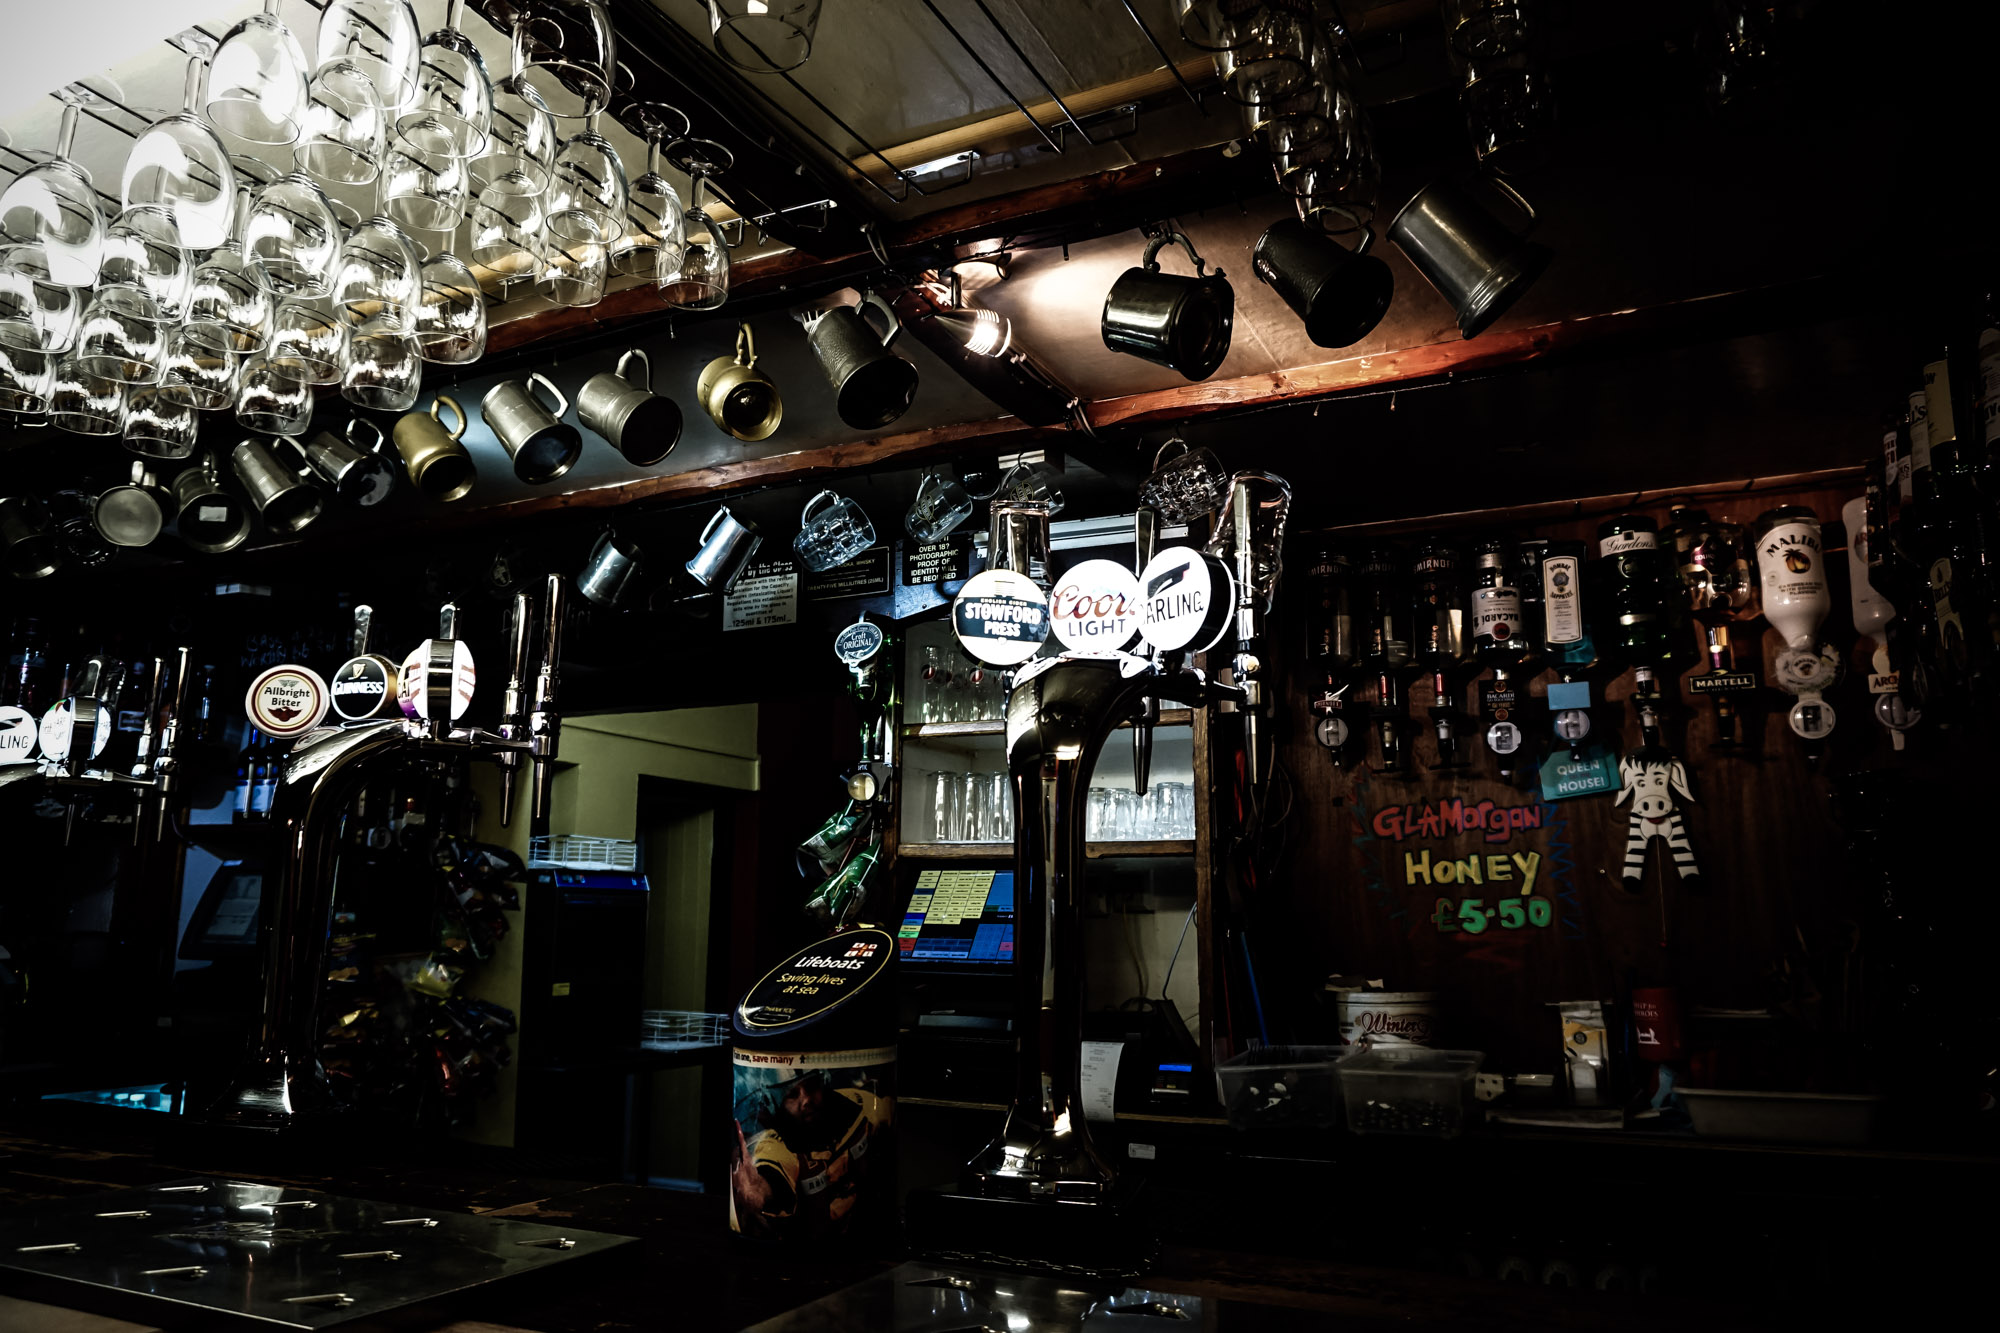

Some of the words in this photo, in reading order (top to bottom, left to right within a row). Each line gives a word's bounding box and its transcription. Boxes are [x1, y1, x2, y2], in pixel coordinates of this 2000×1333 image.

[919, 545, 936, 553] OVER
[1766, 534, 1820, 558] MALIBU
[909, 548, 959, 562] PHOTOGRAPHIC
[917, 560, 939, 568] PROOF
[911, 567, 939, 576] IDENTITY
[965, 603, 1041, 624] STOWFORD
[1140, 591, 1204, 625] ARLING
[732, 619, 755, 627] 125ml
[764, 615, 787, 623] 175ml
[984, 621, 1020, 637] PRESS
[1069, 619, 1125, 637] LIGHT
[843, 638, 873, 649] ORIGINAL
[333, 681, 384, 695] GUINNESS
[1696, 677, 1750, 687] MARTELL
[264, 687, 310, 698] Allbright
[272, 698, 301, 706] Bitter
[1557, 760, 1600, 776] QUEEN
[1558, 777, 1604, 792] HOUSE!
[794, 956, 865, 970] Lifeboats
[776, 973, 817, 986] Saving
[817, 974, 846, 985] lives
[782, 985, 798, 994] at
[796, 986, 819, 995] sea
[752, 1055, 768, 1063] save
[770, 1056, 793, 1066] many
